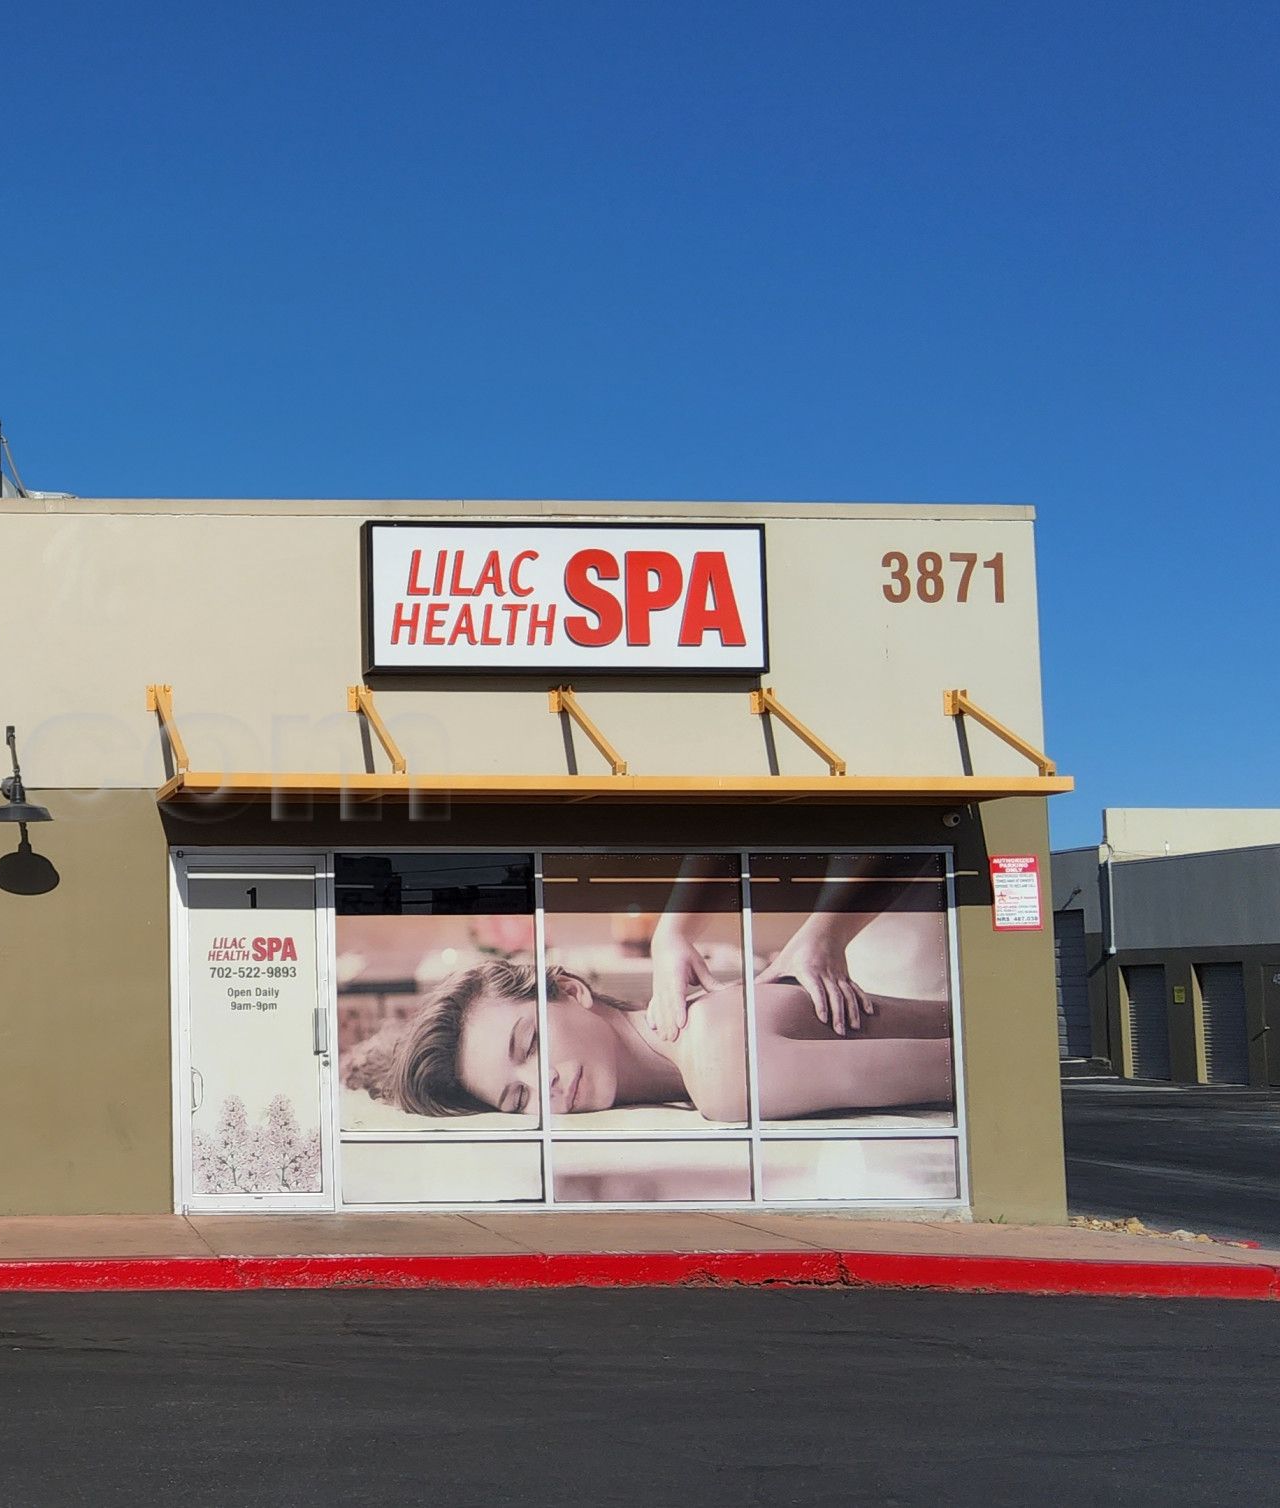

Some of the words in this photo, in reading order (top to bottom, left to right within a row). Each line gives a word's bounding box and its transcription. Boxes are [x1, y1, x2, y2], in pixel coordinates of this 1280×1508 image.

[406, 549, 539, 597] LILAC
[881, 551, 1005, 604] 3871
[564, 548, 746, 647] SPA
[390, 602, 556, 646] HEALTH
[246, 887, 257, 909] 1
[212, 937, 247, 949] LILAC
[252, 937, 298, 962] SPA
[207, 950, 250, 961] HEALTH
[209, 966, 297, 978] 702-522-9893
[227, 987, 252, 998] Open
[255, 987, 280, 998] Daily
[230, 1001, 277, 1012] 9am-9pm
